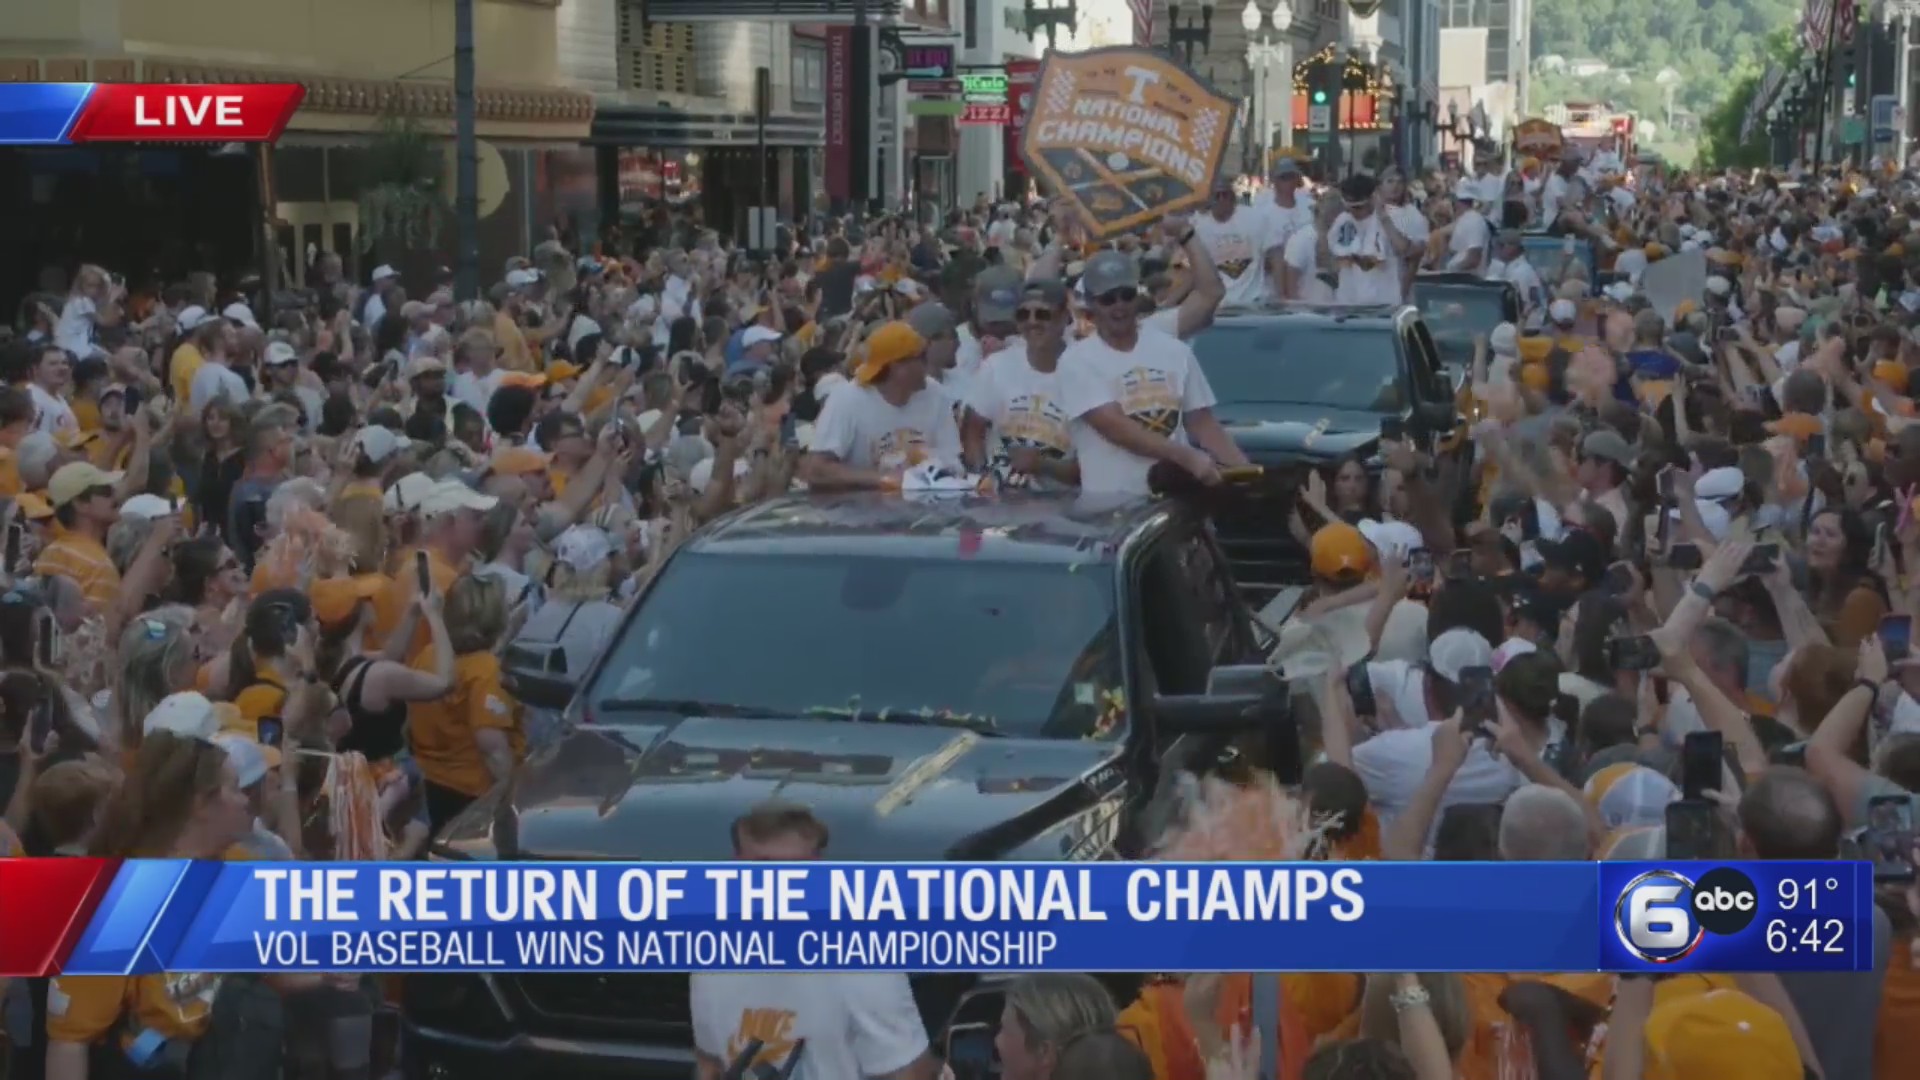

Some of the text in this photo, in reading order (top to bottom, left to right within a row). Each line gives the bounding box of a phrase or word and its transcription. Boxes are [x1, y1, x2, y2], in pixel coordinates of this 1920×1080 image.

[1124, 66, 1160, 104] T
[1073, 97, 1183, 143] NATIONAL
[1036, 119, 1206, 183] CHAMPIONS
[739, 1007, 797, 1042] NIKE
